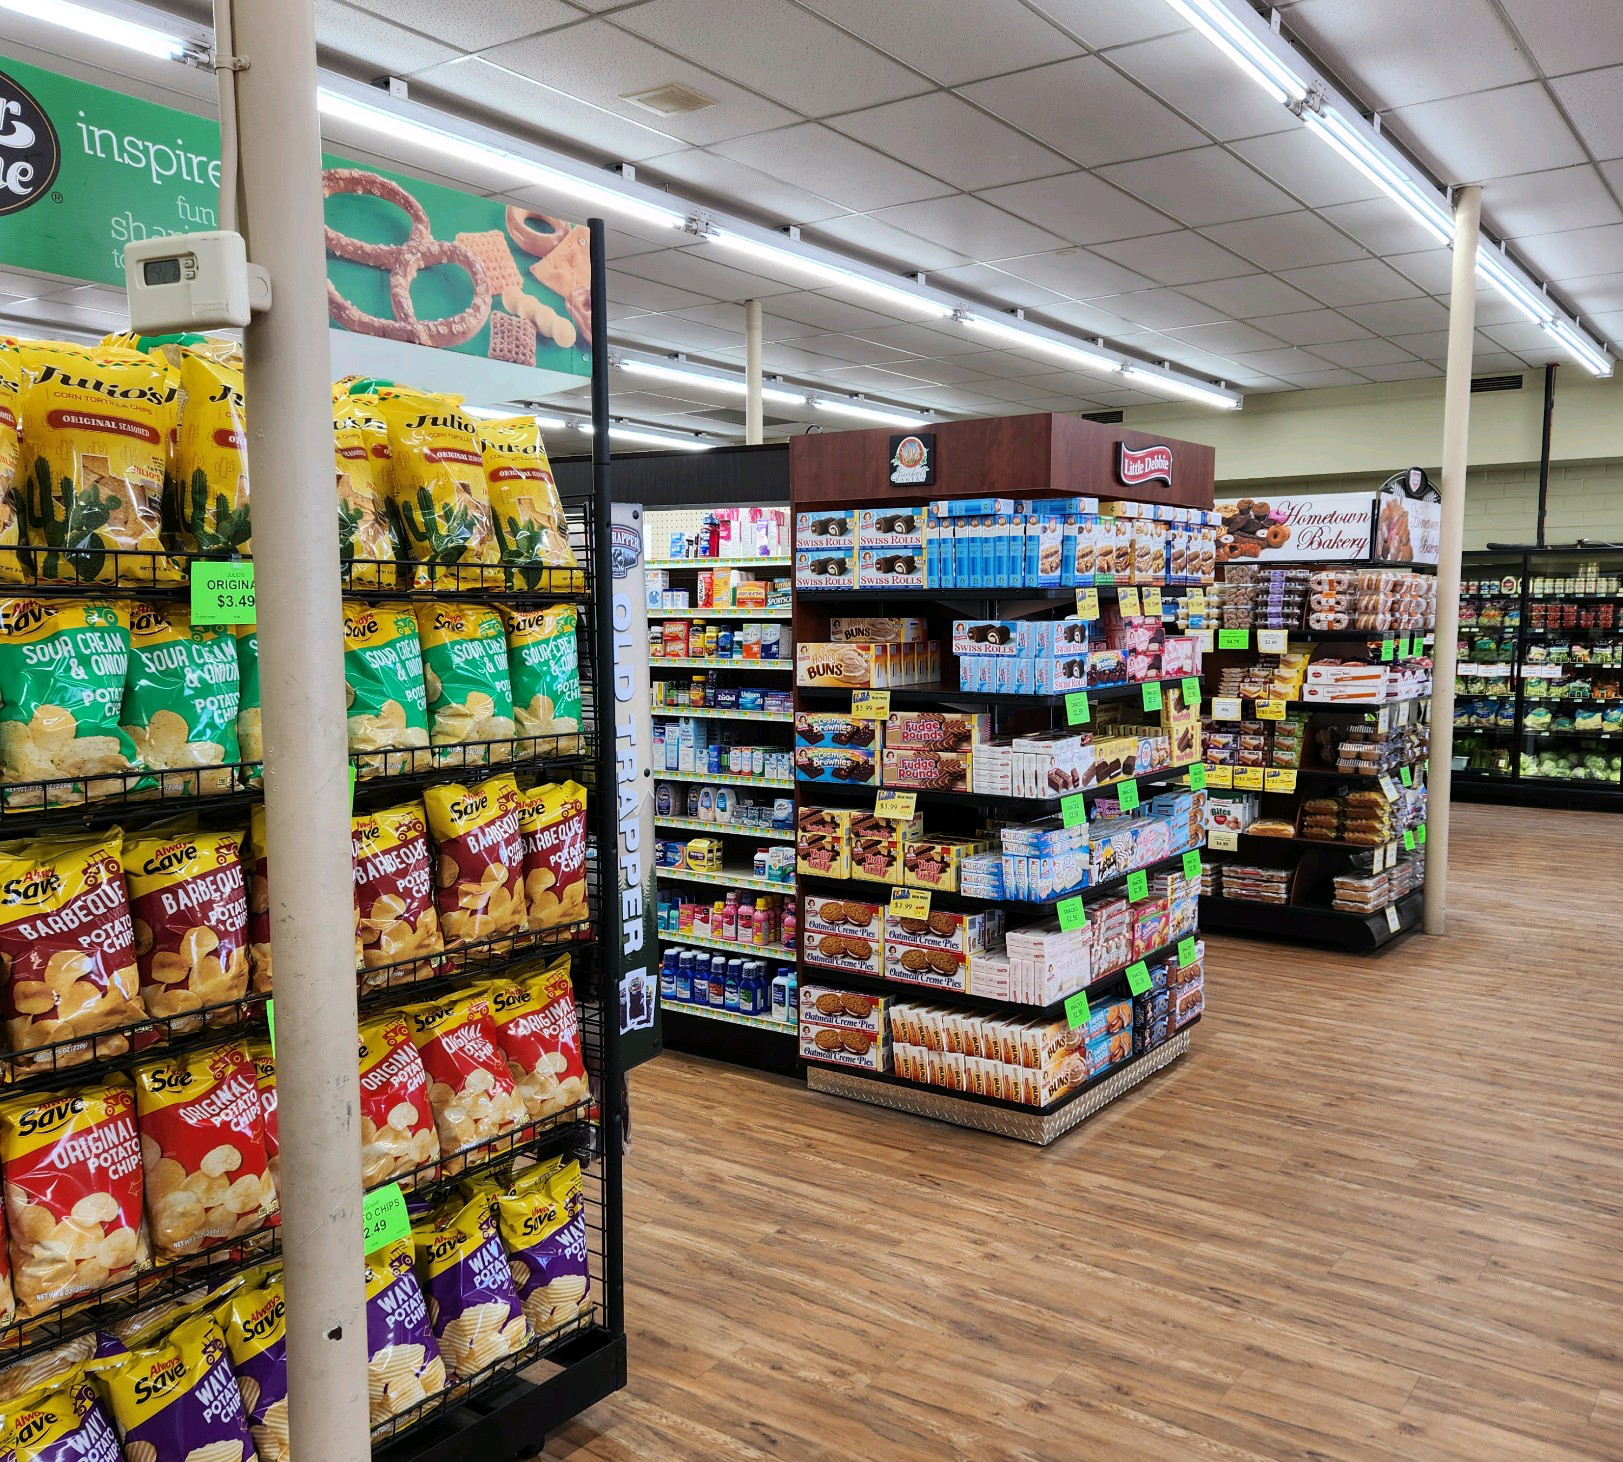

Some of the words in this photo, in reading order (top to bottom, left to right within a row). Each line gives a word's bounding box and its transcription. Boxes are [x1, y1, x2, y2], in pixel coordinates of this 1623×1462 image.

[176, 195, 217, 226] fun
[32, 364, 163, 406] Julio's
[53, 391, 82, 400] CORN
[130, 404, 153, 415] CHIPS
[62, 415, 117, 429] ORIGINAL
[119, 422, 150, 437] SEASONED
[437, 452, 468, 460] ORIGINAL
[1124, 457, 1144, 476] Little
[1144, 454, 1169, 473] Debbie
[1278, 500, 1369, 527] Hometown
[611, 530, 639, 550] RAPPER
[797, 538, 824, 547] SWISS
[825, 537, 853, 546] ROLLS
[860, 536, 889, 545] SWISS
[891, 535, 921, 544] ROLLS
[1297, 525, 1368, 559] Bakery
[797, 577, 823, 586] SWISS
[825, 577, 852, 585] ROLLS
[860, 576, 889, 585] SWISS
[892, 576, 922, 584] ROLLS
[217, 594, 255, 609] $3.49
[844, 627, 870, 640] BUNS
[22, 636, 73, 665] SOUR
[76, 632, 126, 657] CREAM
[365, 646, 398, 669] SOUR
[522, 646, 551, 667] SOUR
[612, 592, 635, 702] OLD
[954, 643, 982, 651] SWISS
[985, 644, 1014, 653] ROLLS
[1055, 644, 1071, 653] SWISS
[70, 658, 88, 680] &
[91, 653, 128, 677] ONION
[141, 645, 189, 673] SOUR
[812, 653, 836, 664] Honey
[184, 667, 202, 688] &
[396, 664, 407, 681] &
[807, 663, 843, 679] BUNS
[1054, 682, 1070, 690] SWISS
[813, 723, 851, 733] Brownies
[902, 730, 944, 742] Rounds
[903, 720, 940, 732] Fudge
[813, 757, 851, 768] Brownies
[900, 757, 936, 770] Fudge
[897, 767, 940, 780] Rounds
[450, 796, 488, 822] Save
[1211, 808, 1232, 816] Bites
[614, 714, 643, 956] TRAPPER
[143, 845, 198, 875] Save
[807, 858, 832, 873] Buddy
[810, 849, 833, 861] Nutty
[865, 854, 889, 868] Nutty
[862, 865, 888, 878] Buddy
[917, 860, 941, 874] Nutty
[3, 872, 61, 905] Save
[915, 871, 942, 885] Buddy
[161, 865, 245, 915] BARBEQUE
[18, 880, 127, 940] BARBEQUE
[894, 902, 913, 910] $3.99
[808, 921, 836, 934] Oatmeal
[836, 925, 859, 937] Creme
[860, 929, 876, 939] Pies
[888, 930, 918, 942] Oatmeal
[918, 935, 942, 946] Creme
[943, 939, 960, 950] Pies
[807, 952, 836, 965] Oatmeal
[836, 957, 858, 968] Creme
[858, 961, 875, 971] Pies
[889, 968, 919, 981] Oatmeal
[920, 973, 944, 984] Creme
[945, 977, 962, 989] Pies
[493, 991, 531, 1012] Save
[415, 1007, 455, 1032] Save
[804, 1012, 836, 1025] Oatmeal
[836, 1017, 858, 1028] Creme
[858, 1020, 876, 1030] Pies
[900, 1022, 909, 1042] BUNS
[954, 1032, 962, 1052] BUNS
[803, 1047, 835, 1061] Oatmeal
[834, 1052, 856, 1063] Creme
[856, 1056, 874, 1067] Pies
[973, 1036, 981, 1057] BUNS
[1047, 1036, 1066, 1060] BUNS
[1032, 1048, 1040, 1068] BUNS
[1048, 1073, 1069, 1098] BUNS
[178, 1075, 254, 1125] ORIGINAL
[210, 1089, 258, 1128] POTATO
[18, 1098, 85, 1137] Save
[230, 1102, 261, 1132] CHIPS
[51, 1117, 137, 1170] ORIGINAL
[87, 1137, 140, 1174] POTATO
[374, 1199, 400, 1217] CHIPS
[522, 1208, 557, 1236] Save
[426, 1233, 467, 1264] Save
[377, 1272, 419, 1314] WAVY
[250, 1293, 281, 1323] Always
[242, 1301, 285, 1343] Save
[150, 1355, 181, 1378] Always
[134, 1361, 187, 1405] Save
[195, 1358, 233, 1407] WAVY
[202, 1376, 239, 1425] POTATO
[70, 1407, 107, 1455] WAVY
